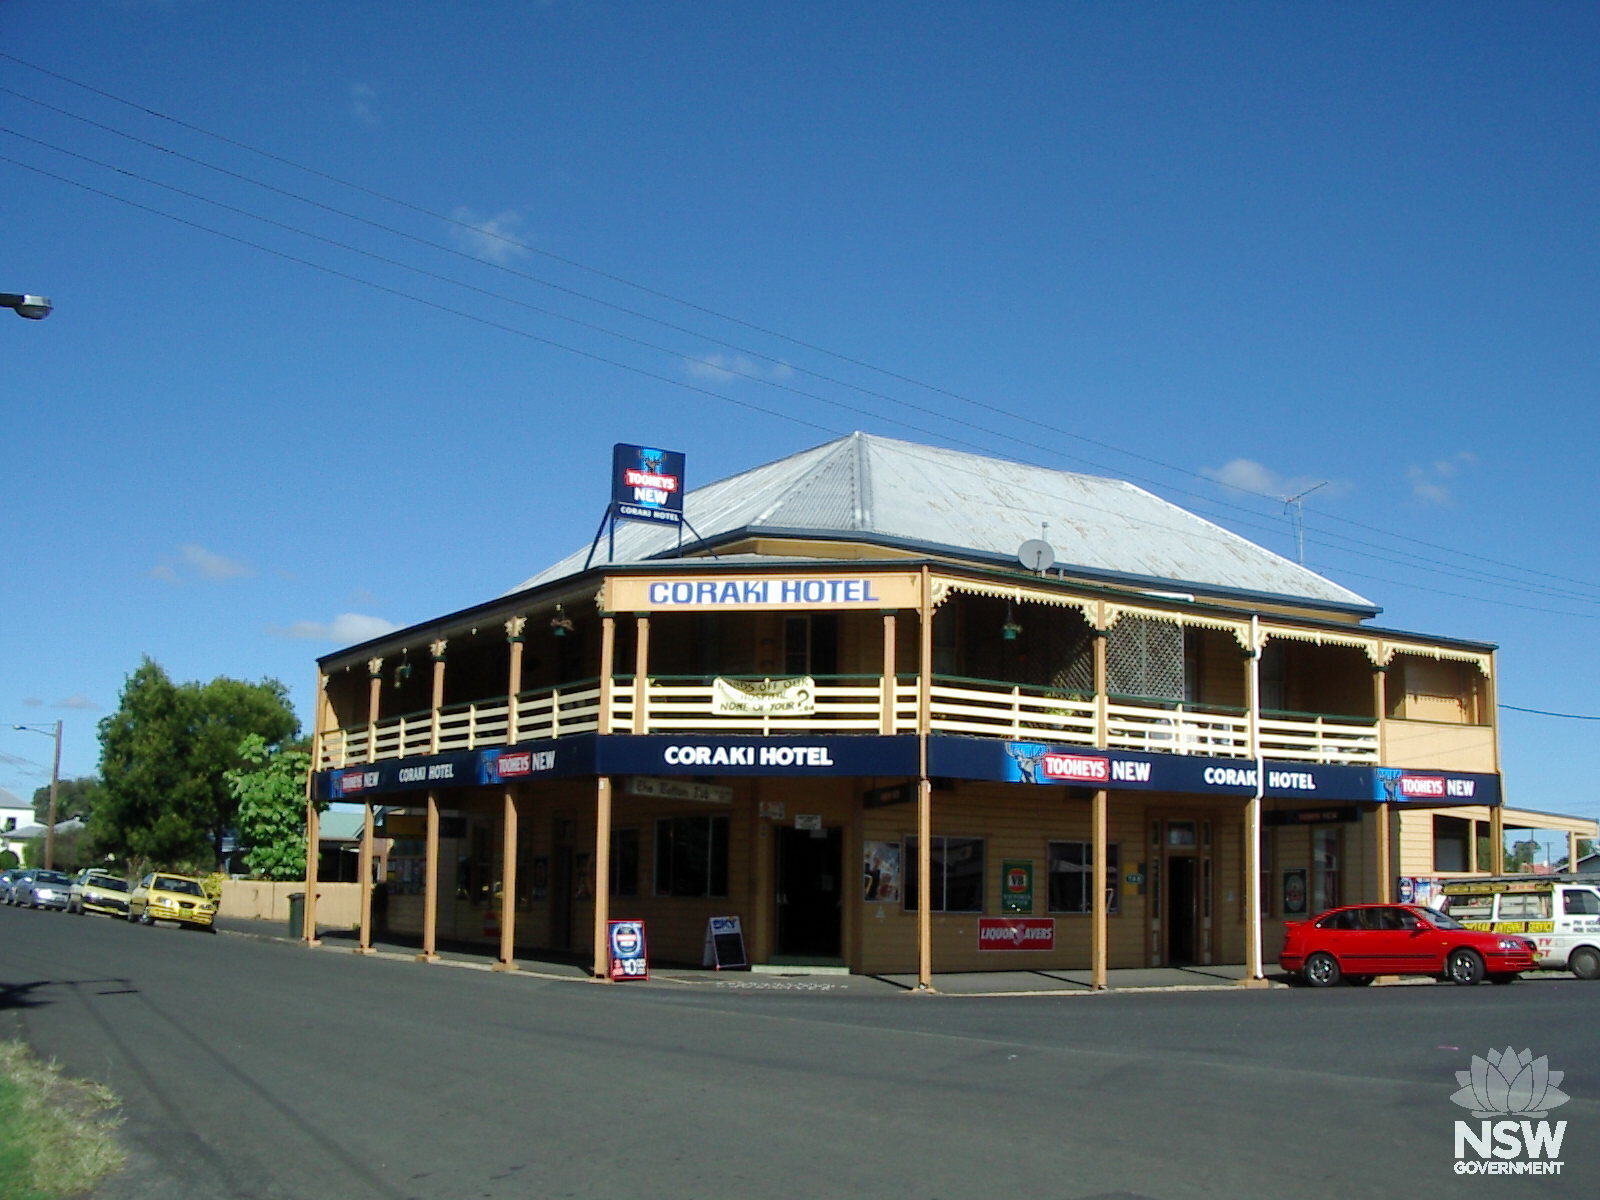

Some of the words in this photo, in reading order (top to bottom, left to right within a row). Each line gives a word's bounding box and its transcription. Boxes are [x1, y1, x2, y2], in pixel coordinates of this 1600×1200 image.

[627, 472, 675, 490] TOOHEYS
[634, 487, 668, 505] NEW
[620, 506, 652, 517] CORAKI
[653, 511, 680, 521] HOTEL
[649, 580, 769, 604] CORAKI
[781, 579, 879, 602] HOTEL
[770, 701, 795, 711] YOUR
[532, 751, 555, 770] NEW
[664, 746, 754, 765] CORAKI
[760, 747, 833, 766] HOTEL
[399, 767, 426, 782] CORAKI
[429, 764, 454, 780] HOTEL
[1045, 757, 1105, 777] TOOHEYS
[1112, 760, 1150, 782] NEW
[1204, 767, 1258, 786] CORAK
[1269, 772, 1316, 789] HOTEL
[364, 772, 379, 788] NEW
[1401, 779, 1443, 794] TOOHEYS
[1446, 779, 1474, 796] NEW
[981, 928, 1014, 940] LIQUOR
